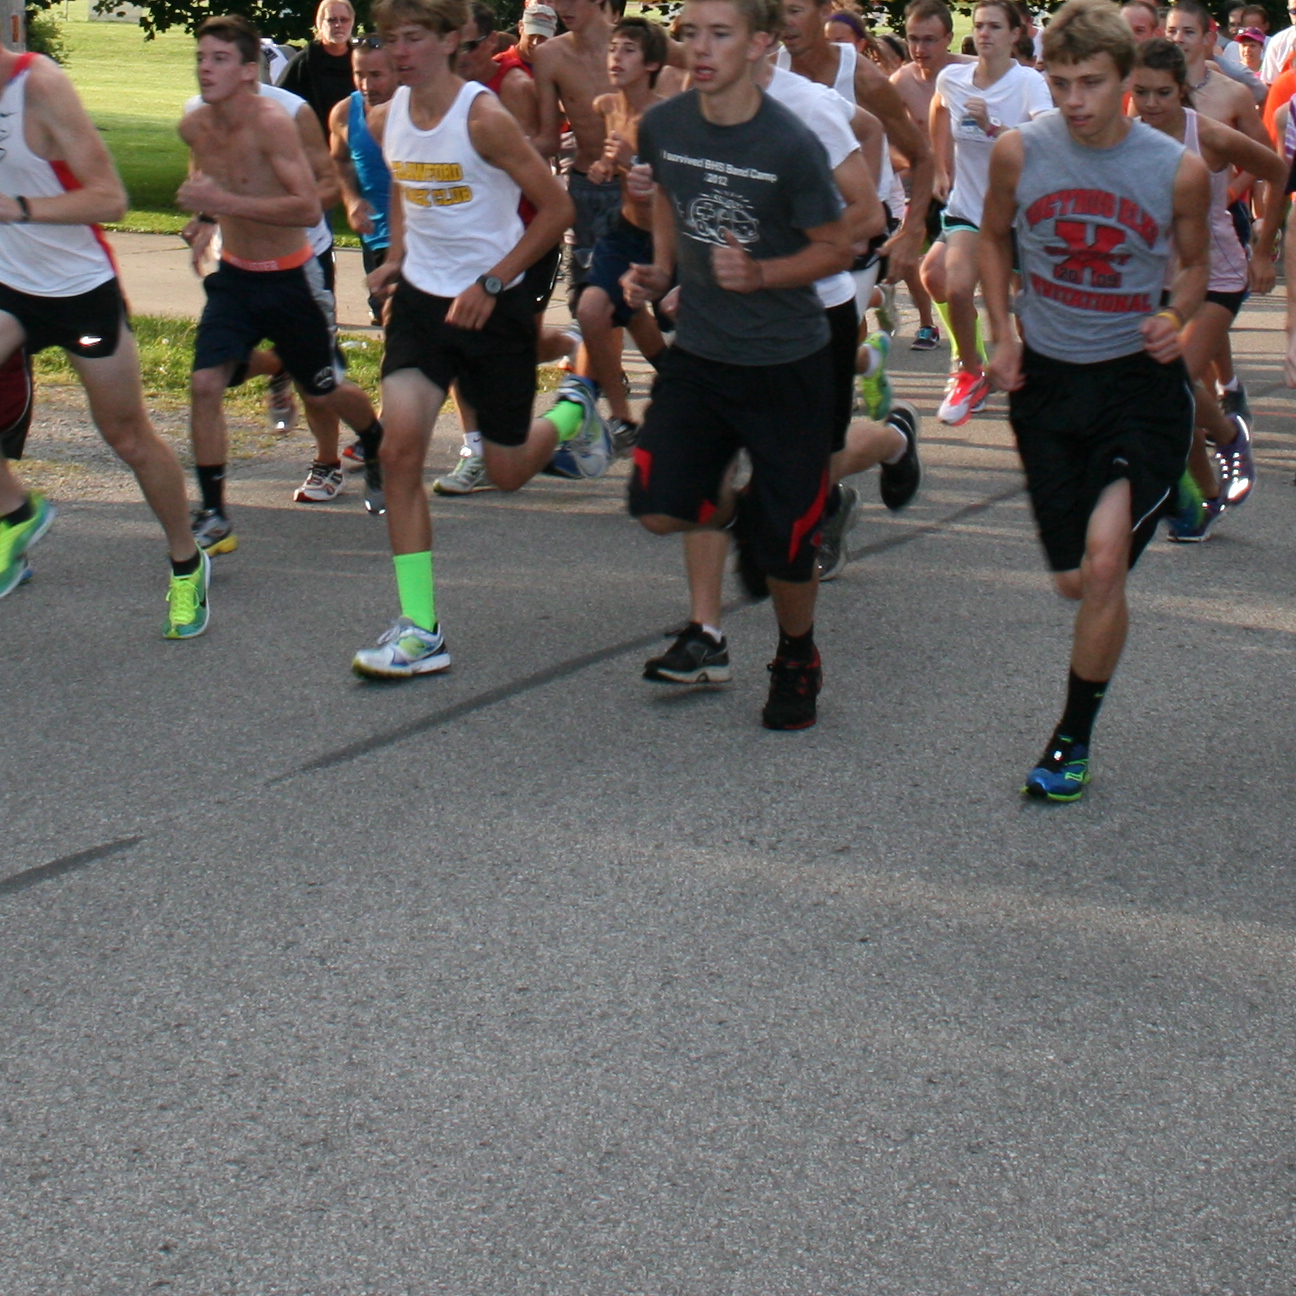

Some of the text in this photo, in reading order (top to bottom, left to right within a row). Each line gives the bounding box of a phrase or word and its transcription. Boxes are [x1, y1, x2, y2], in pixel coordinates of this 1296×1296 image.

[704, 158, 725, 173] BHS
[725, 163, 750, 178] Band
[750, 168, 778, 183] Camp
[431, 185, 474, 206] CLUB
